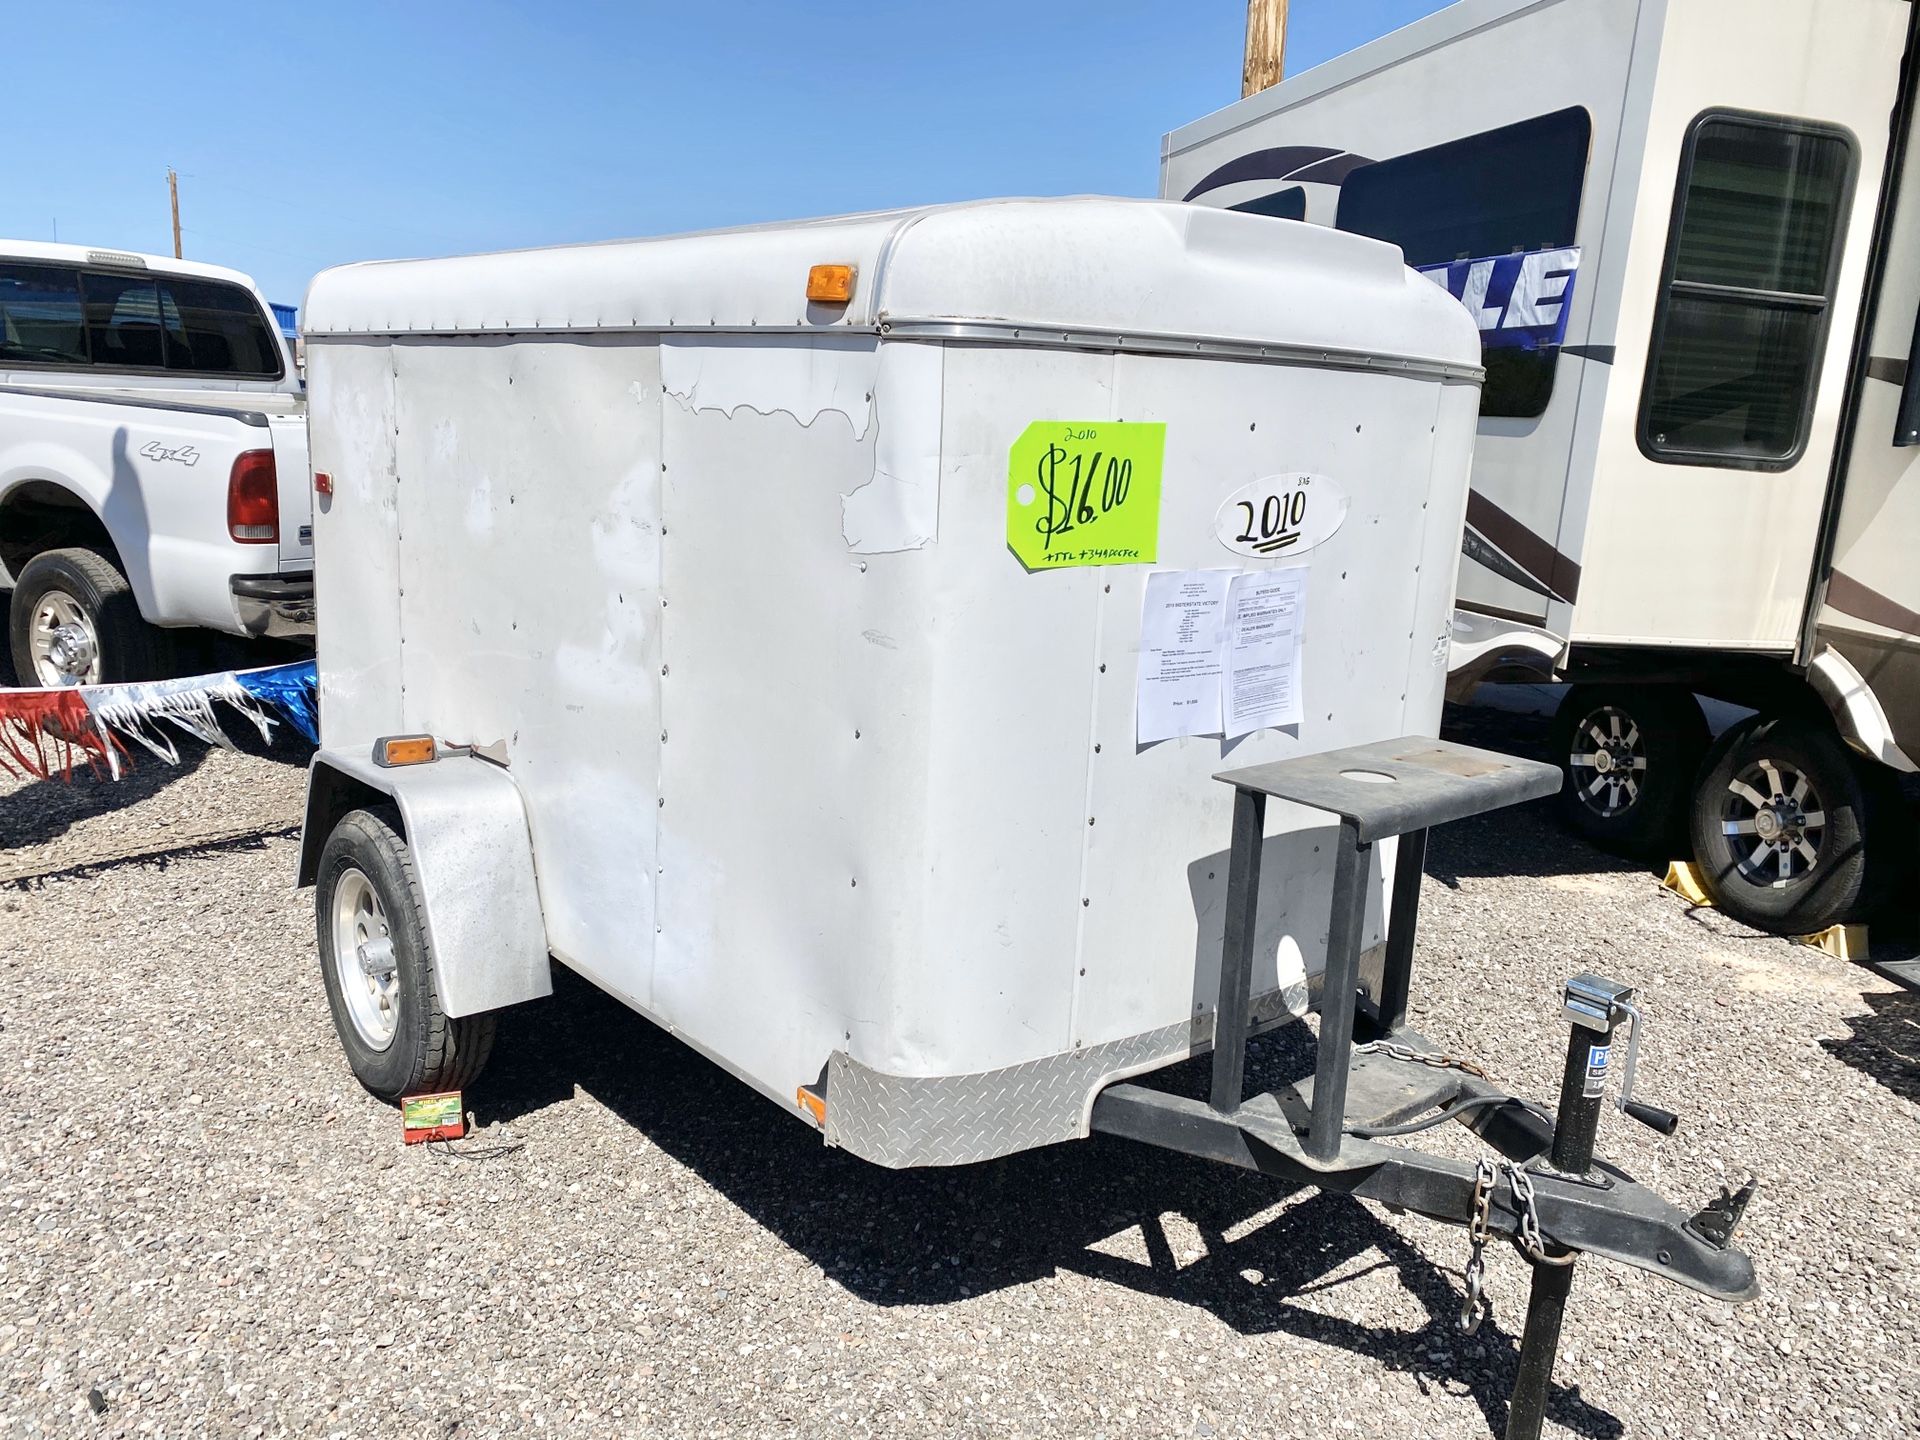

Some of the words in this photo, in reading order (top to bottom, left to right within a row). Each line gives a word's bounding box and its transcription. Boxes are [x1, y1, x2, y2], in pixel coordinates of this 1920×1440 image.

[1421, 249, 1580, 331] LE
[140, 440, 201, 467] 4x4
[1064, 427, 1097, 442] 2010
[1235, 490, 1306, 543] 2010
